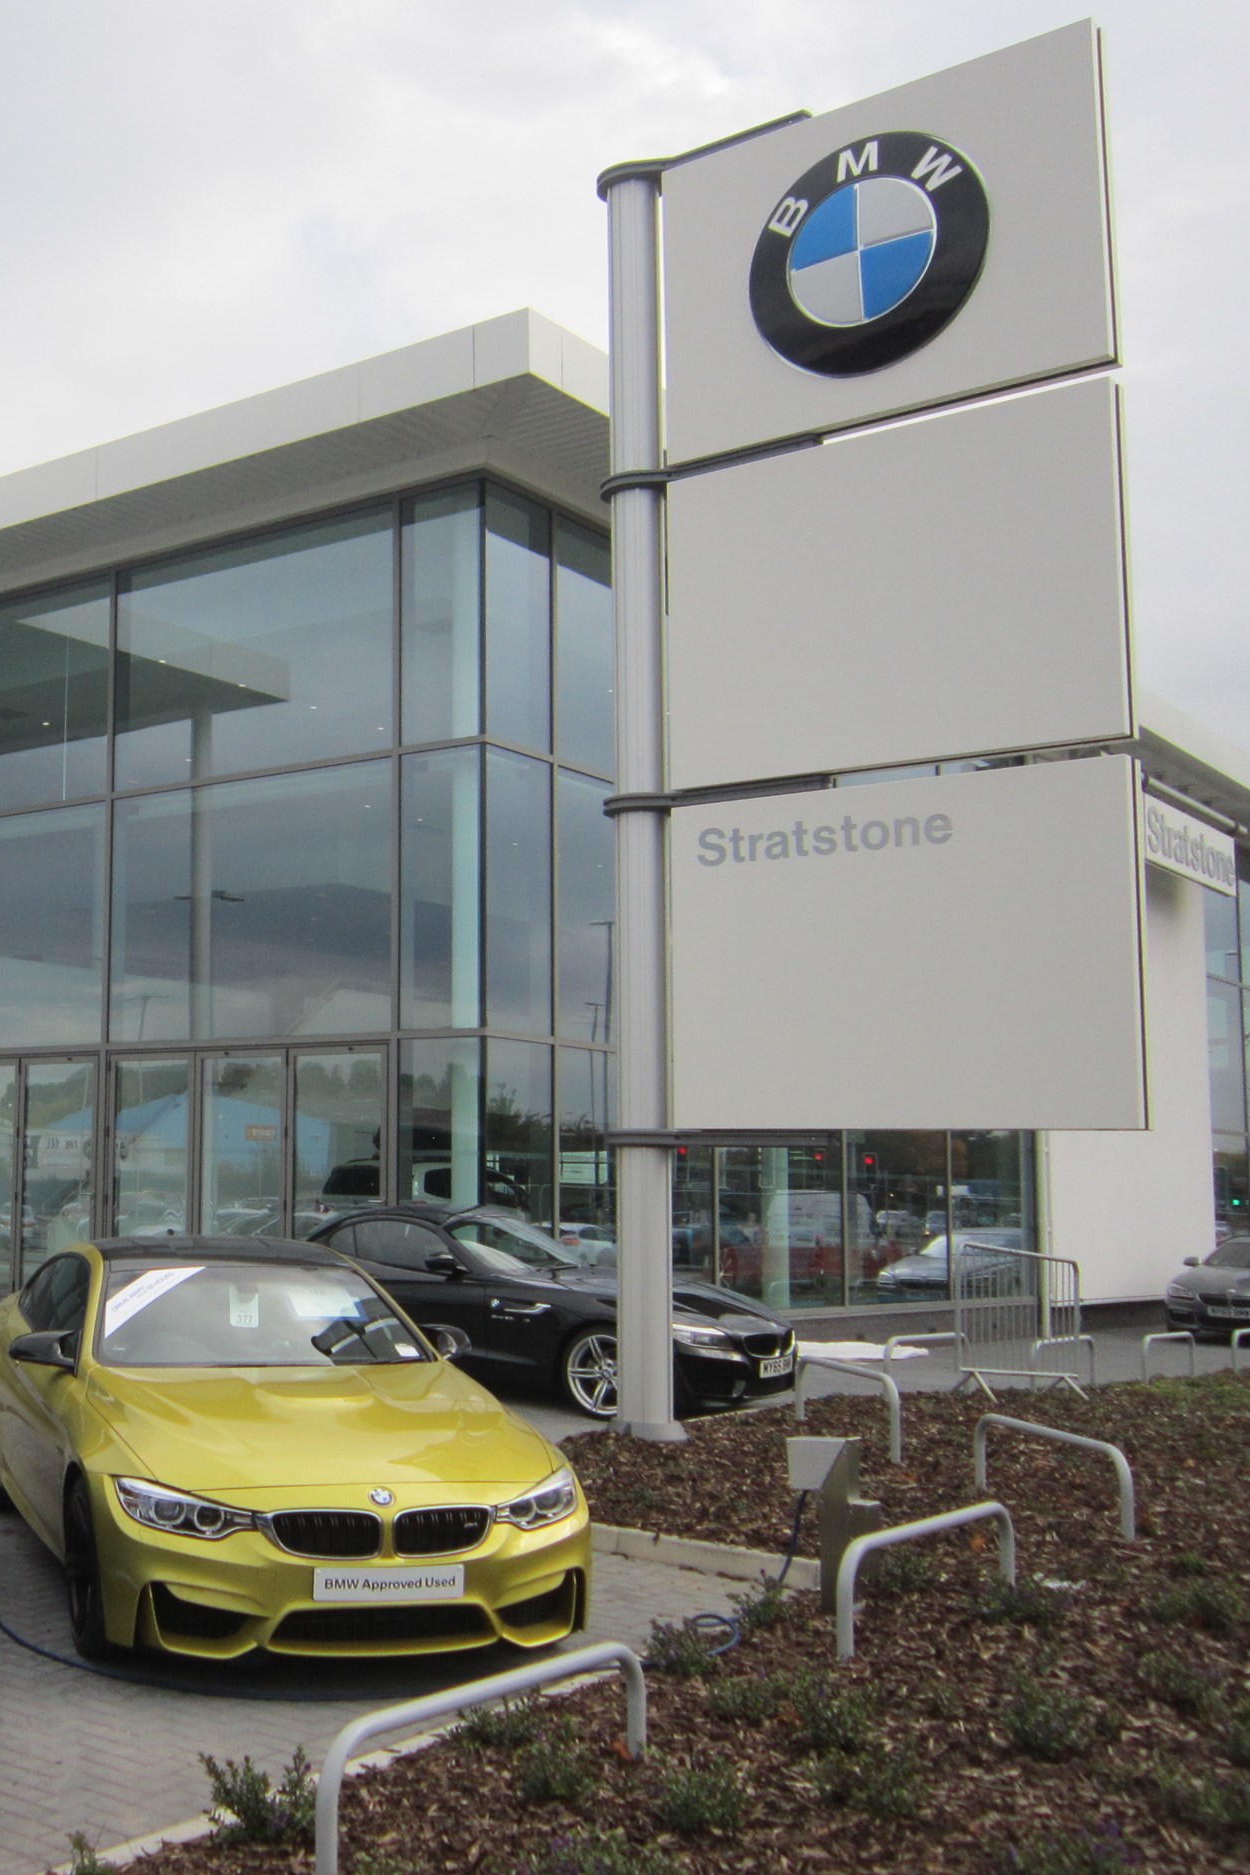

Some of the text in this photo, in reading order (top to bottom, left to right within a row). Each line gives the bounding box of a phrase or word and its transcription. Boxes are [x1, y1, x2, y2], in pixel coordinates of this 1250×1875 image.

[768, 140, 963, 238] BMW
[697, 813, 953, 867] Stratstone
[1147, 805, 1235, 888] Stratstone
[236, 1313, 253, 1324] 377
[324, 1576, 456, 1592] BMW Approved Used
